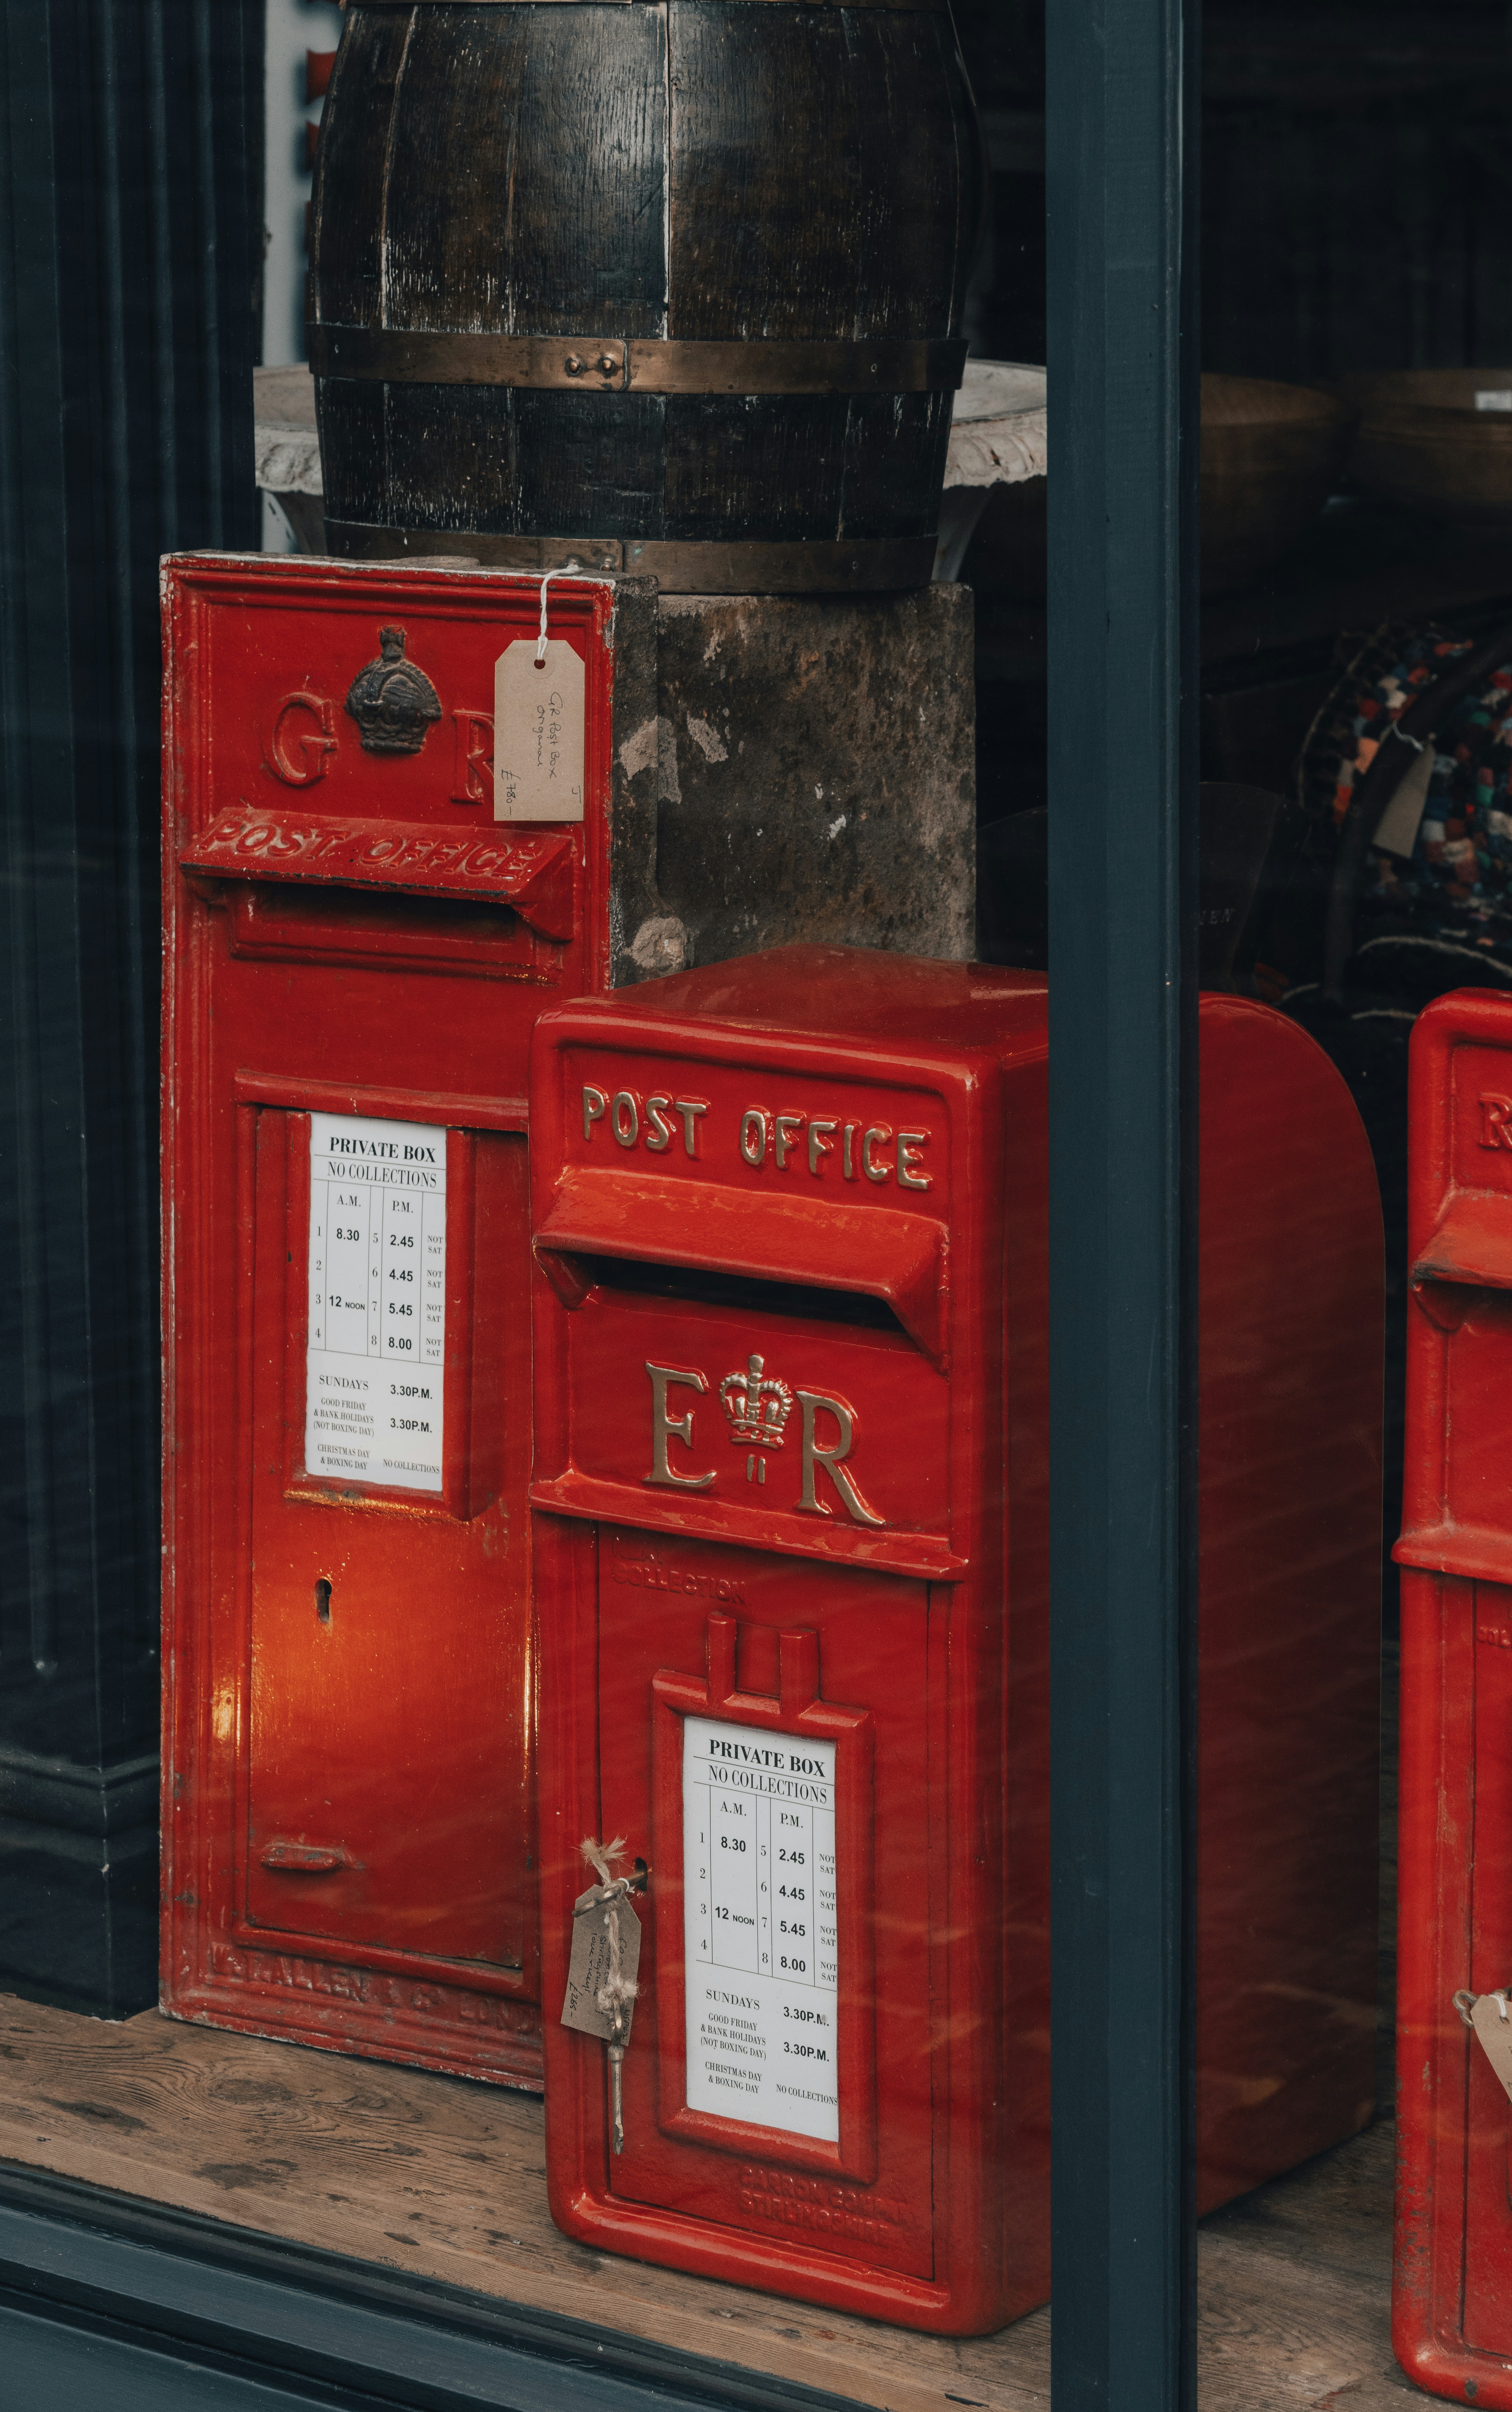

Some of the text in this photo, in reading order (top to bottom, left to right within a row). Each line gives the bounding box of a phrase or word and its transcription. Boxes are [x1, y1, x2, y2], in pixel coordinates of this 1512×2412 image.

[200, 818, 545, 879] POST OFFICE
[582, 1083, 931, 1190] POST OFFICE
[329, 1137, 436, 1162] PRIVATE BOX
[328, 1162, 436, 1188] NO COLLECTIONS
[337, 1195, 413, 1213] A.M. P.M.
[318, 1226, 321, 1236] 1
[337, 1229, 359, 1241] 8.30
[373, 1234, 378, 1243] 5
[390, 1235, 413, 1247] 2.45
[316, 1261, 321, 1270] 2
[372, 1267, 378, 1277] 6
[389, 1269, 413, 1281] 4.45
[316, 1295, 320, 1304] 3
[329, 1296, 341, 1306] 12
[372, 1302, 377, 1311] 7
[389, 1303, 412, 1315] 5.45
[315, 1329, 320, 1338] 4
[372, 1335, 376, 1345] 8
[389, 1337, 412, 1350] 8.00
[319, 1375, 432, 1399] SUNDAYS 3.30P.M.
[321, 1398, 366, 1410] GOOD FRIDAY
[314, 1418, 432, 1437] (NOT BOXING DAY) 3.30P.M.
[320, 1410, 338, 1419] BANK
[341, 1413, 373, 1424] HOLIDAYS
[318, 1444, 370, 1458] CHRISTMAS DAY
[643, 1360, 717, 1488] E
[795, 1386, 885, 1524] R
[327, 1457, 353, 1468] BOXING
[383, 1459, 392, 1467] NO
[394, 1461, 440, 1474] COLLECTIONS
[709, 1739, 825, 1777] PRIVATE BOX
[709, 1765, 827, 1804] NO COLLECTIONS
[720, 1801, 803, 1828] A.M. P.M.
[700, 1832, 835, 1864] 1 8.30 5 2.45 NOT
[820, 1866, 835, 1875] SAT
[700, 1868, 836, 1900] 2 6 4.45 NOT
[821, 1902, 835, 1911] SAT
[701, 1904, 836, 1936] 3 12 NOON 7 5.45 NOT
[821, 1937, 835, 1946] SAT
[701, 1940, 837, 1972] 4 8 8.00 NOT
[822, 1973, 836, 1982] SAT
[706, 1989, 760, 2010] SUNDAYS
[709, 2013, 757, 2031] GOOD FRIDAY
[708, 2026, 727, 2037] BANK
[730, 2031, 766, 2046] HOLIDAYS
[701, 2037, 829, 2061] (NOT BOXING DAY) 3.30P.M.
[705, 2061, 762, 2081] CHRISTMAS DAY
[716, 2076, 743, 2090] BOXING
[746, 2083, 759, 2093] DAY
[776, 2084, 786, 2094] NO
[788, 2088, 837, 2105] COLLECTIONS
